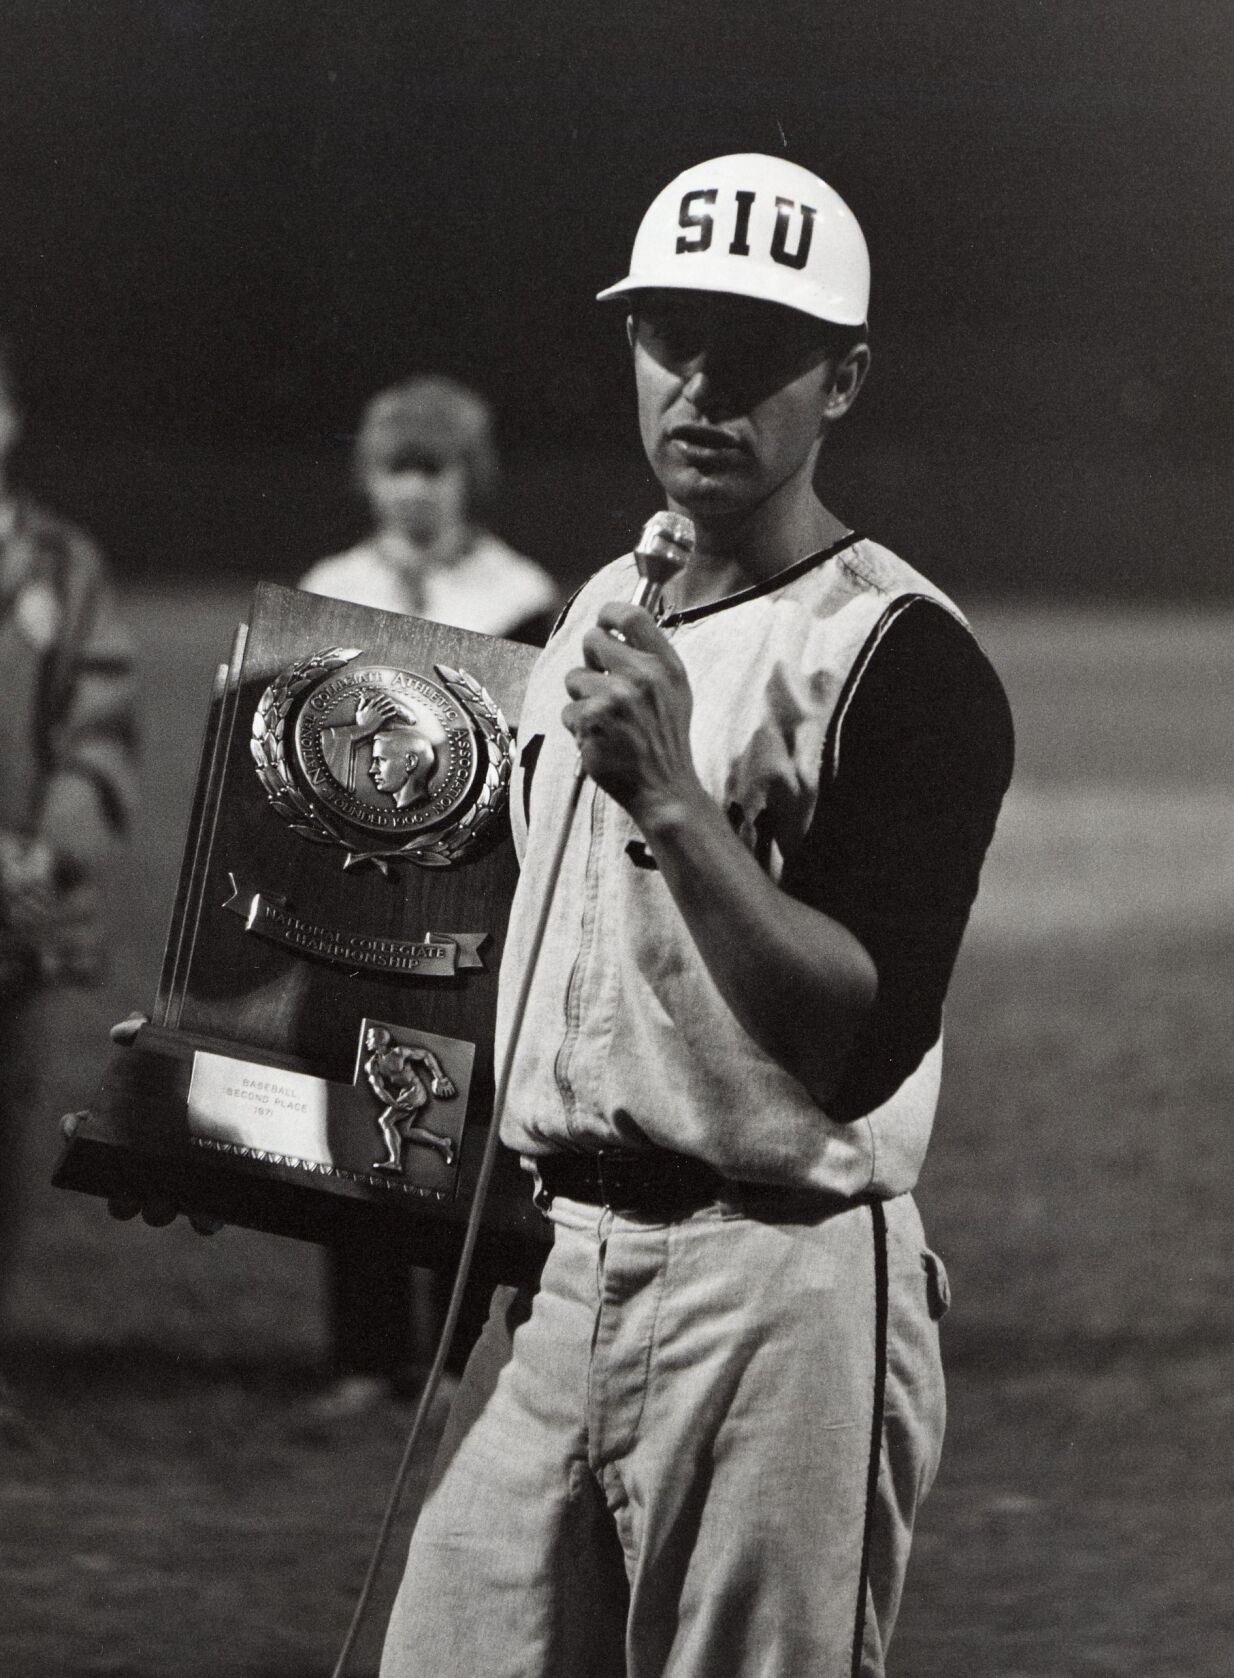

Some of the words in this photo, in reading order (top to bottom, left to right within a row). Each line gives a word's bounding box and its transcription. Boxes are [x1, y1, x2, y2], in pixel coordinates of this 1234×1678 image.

[675, 188, 817, 270] SIU
[311, 671, 384, 711] COLLEGIATE
[390, 672, 458, 721] ATHLETIC
[301, 715, 327, 785] NATIONAL
[432, 728, 472, 815] ASSOCIATION
[265, 905, 342, 944] NATIONAL
[350, 936, 446, 959] COLLEGIATE
[284, 929, 420, 970] CHAMPIONSHIP
[225, 1087, 270, 1104] SECOND
[274, 1099, 308, 1114] PLACE
[242, 1078, 297, 1098] BASEBALL
[254, 1106, 273, 1117] 1971
